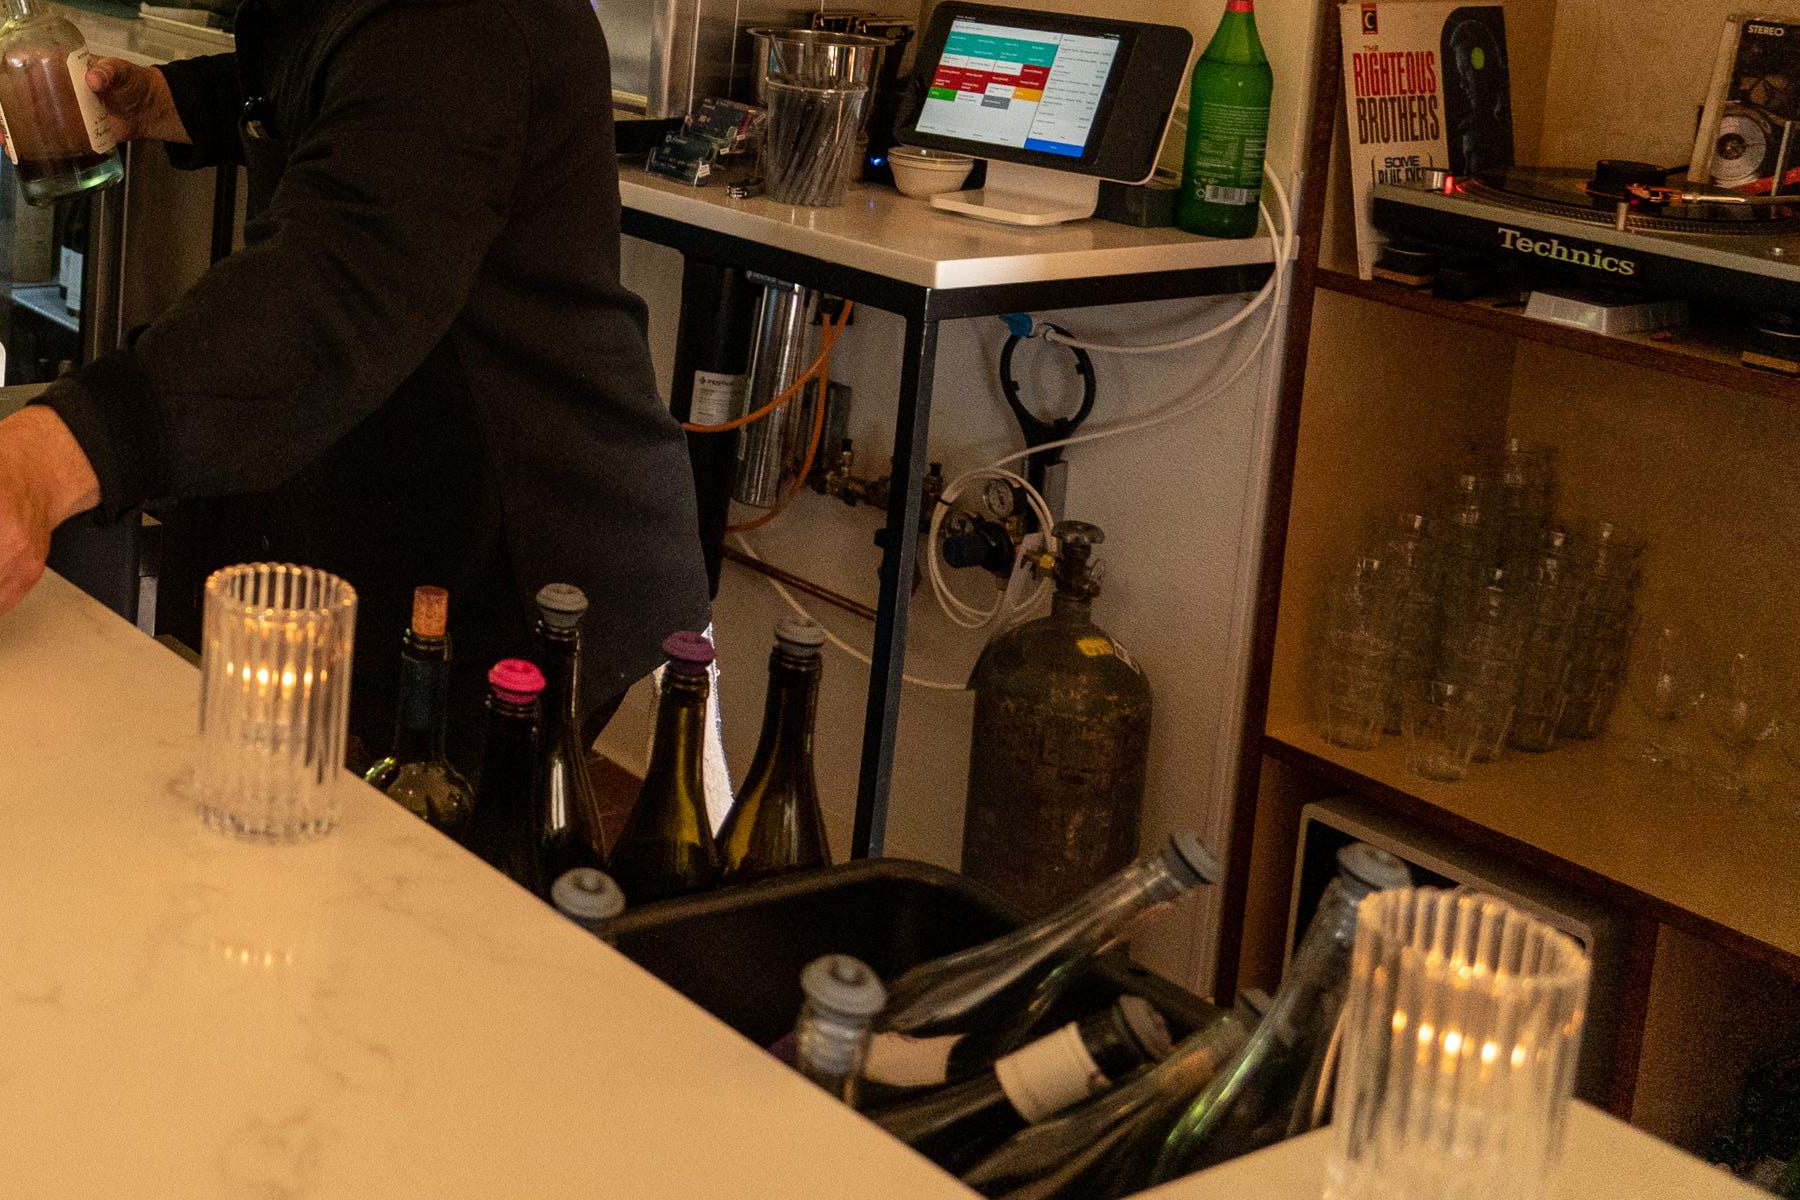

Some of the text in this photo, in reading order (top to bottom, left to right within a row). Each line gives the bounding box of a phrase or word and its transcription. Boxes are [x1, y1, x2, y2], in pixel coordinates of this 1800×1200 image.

[1747, 25, 1785, 37] STEREO
[1352, 51, 1438, 97] RIGHTEOUS
[1355, 95, 1440, 144] BROTHERS
[1384, 155, 1420, 169] SOME
[1497, 227, 1636, 277] Technics
